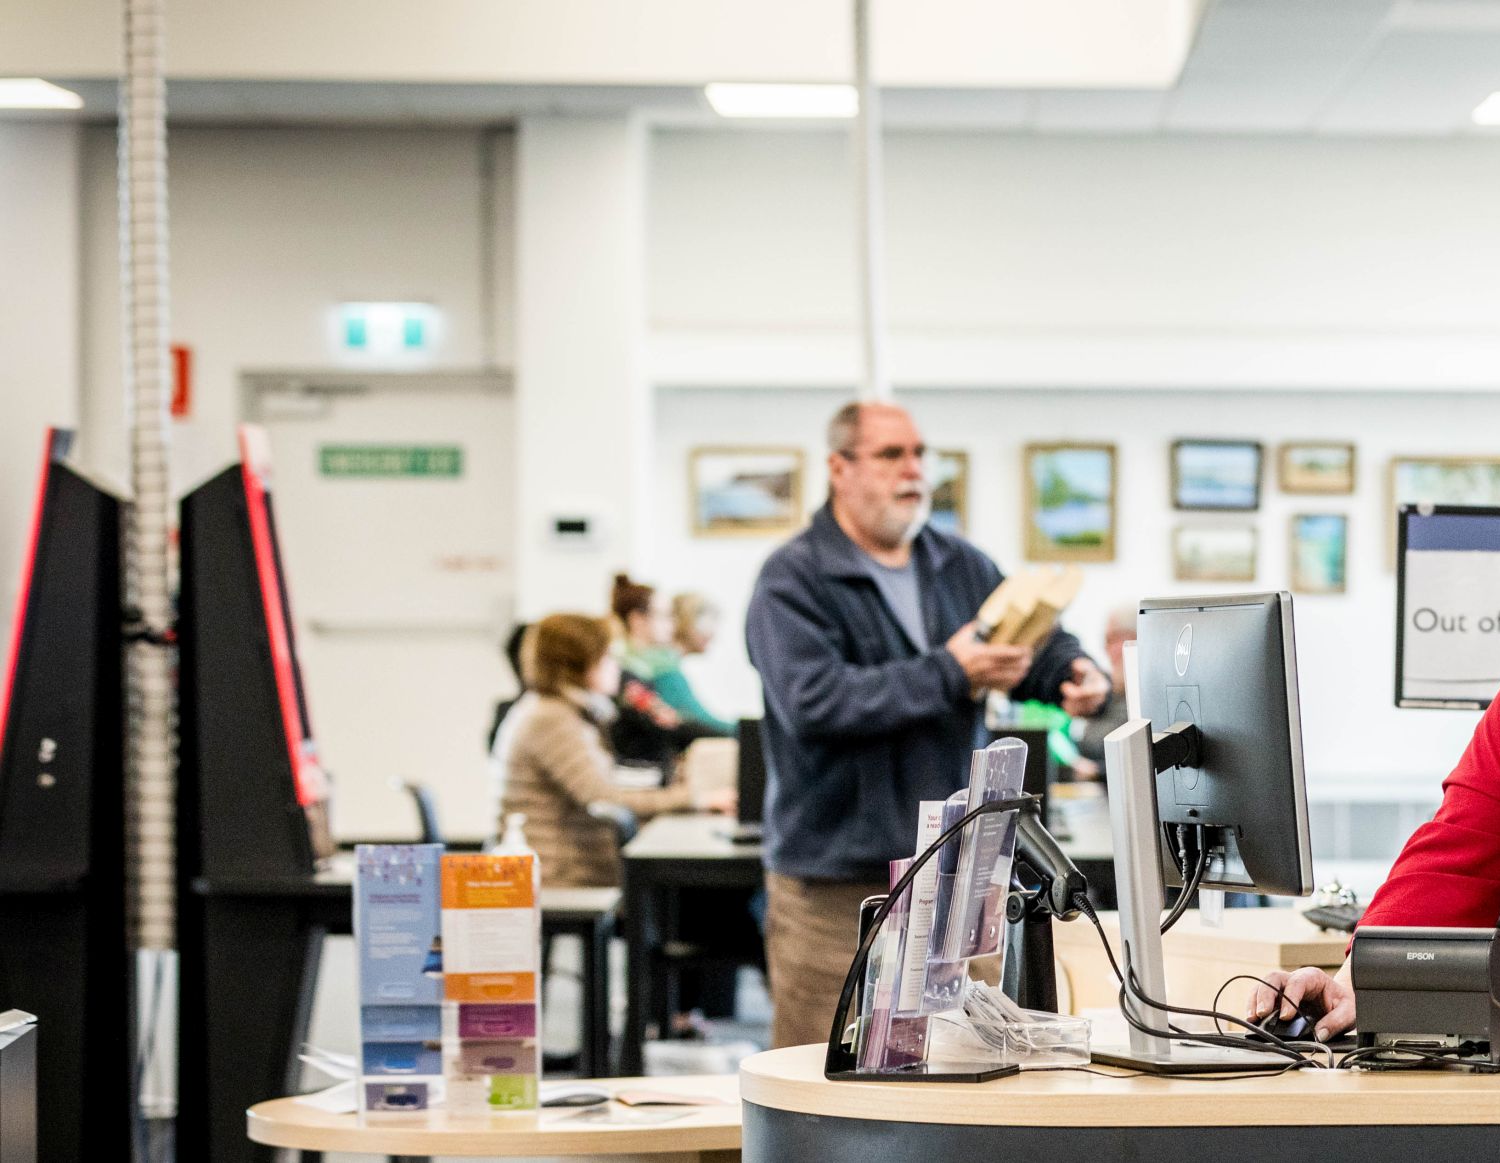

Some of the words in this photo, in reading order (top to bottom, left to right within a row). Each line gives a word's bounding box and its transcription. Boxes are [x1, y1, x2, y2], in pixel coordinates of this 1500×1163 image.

[1413, 608, 1466, 633] Out
[1177, 643, 1189, 656] DELL
[1407, 952, 1435, 961] EPSON
